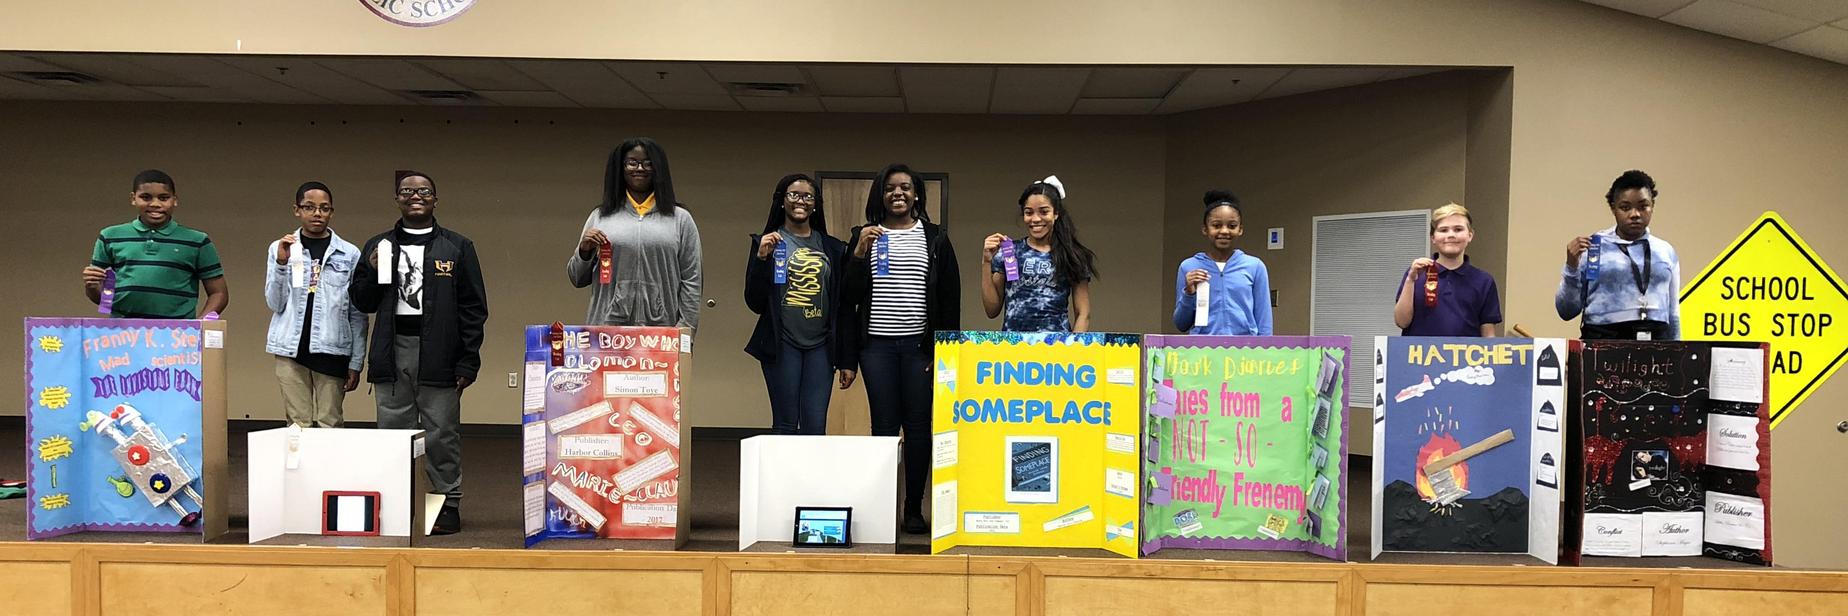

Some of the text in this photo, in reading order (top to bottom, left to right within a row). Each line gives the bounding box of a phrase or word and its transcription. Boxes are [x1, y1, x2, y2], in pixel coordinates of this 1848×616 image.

[1720, 276, 1815, 301] SCHOOL
[1703, 312, 1833, 337] BUS STOP
[83, 329, 140, 359] Franny
[171, 329, 199, 349] Ste
[563, 331, 591, 350] HE
[599, 332, 636, 350] BOY
[98, 352, 201, 371] Mad scientis
[1408, 343, 1534, 367] HATCHET
[976, 361, 1097, 388] FINDING
[952, 398, 1112, 425] SOMEPLACE
[1220, 382, 1261, 418] from
[1281, 396, 1292, 422] a
[1172, 418, 1209, 464] NOT
[1234, 421, 1257, 468] SO
[1719, 428, 1747, 439] Solution
[1012, 447, 1049, 463] FINDING
[1714, 502, 1752, 517] Publisher
[1659, 522, 1690, 534] Author
